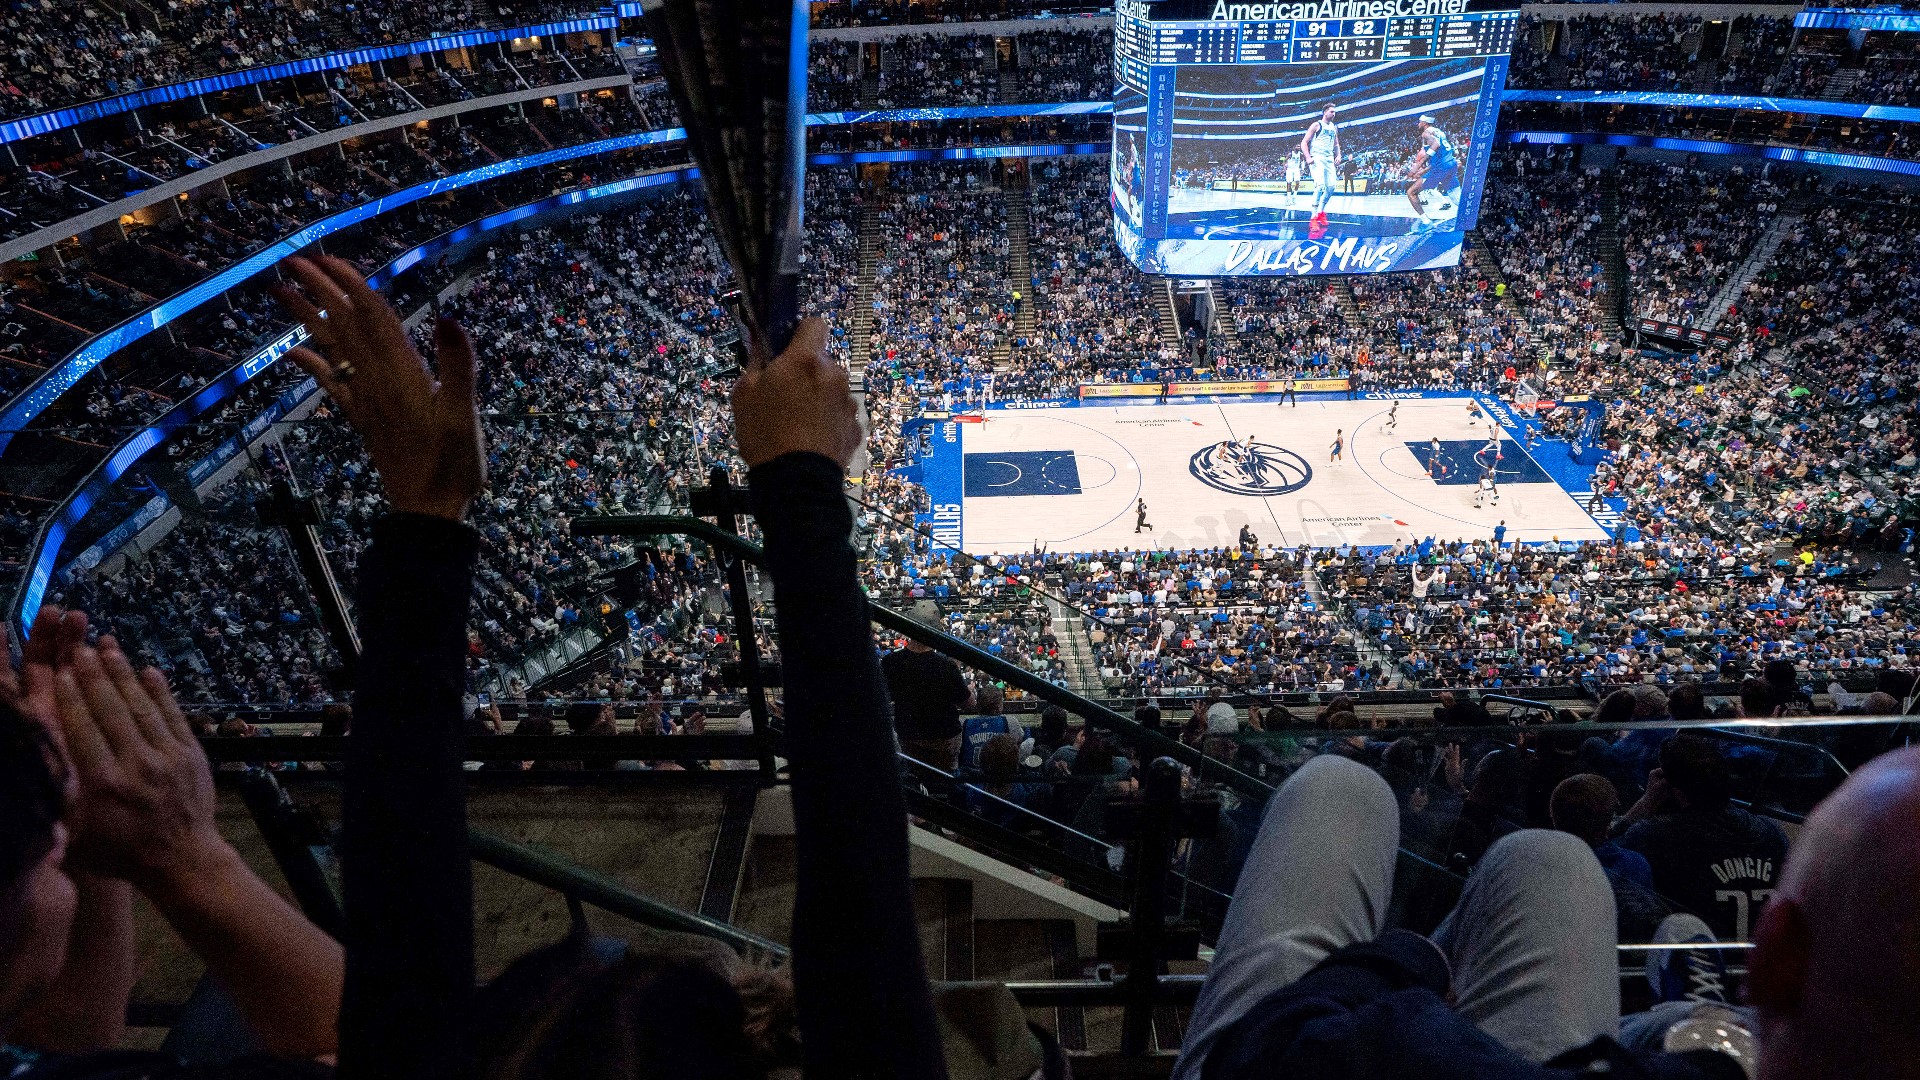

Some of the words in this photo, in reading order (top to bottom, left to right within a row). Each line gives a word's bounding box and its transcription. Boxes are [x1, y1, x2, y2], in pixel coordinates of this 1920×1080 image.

[1211, 0, 1470, 20] AmericanAirlinesCenter
[1309, 22, 1326, 36] 91
[1353, 21, 1374, 34] 82
[1328, 41, 1348, 50] 11.1
[1156, 74, 1166, 126] DALLAS
[1485, 64, 1500, 116] DALLAS
[1152, 152, 1162, 224] MAVERICKS
[1464, 143, 1486, 216] MAVERICKS
[1225, 240, 1320, 274] DALLAS
[1320, 238, 1398, 272] MAVS
[1005, 400, 1060, 408] chime
[1365, 392, 1422, 400] chime
[1481, 398, 1518, 428] shiftkey
[942, 420, 956, 442] shift
[932, 504, 961, 550] DALLAS
[1710, 854, 1772, 885] DONČIĆ
